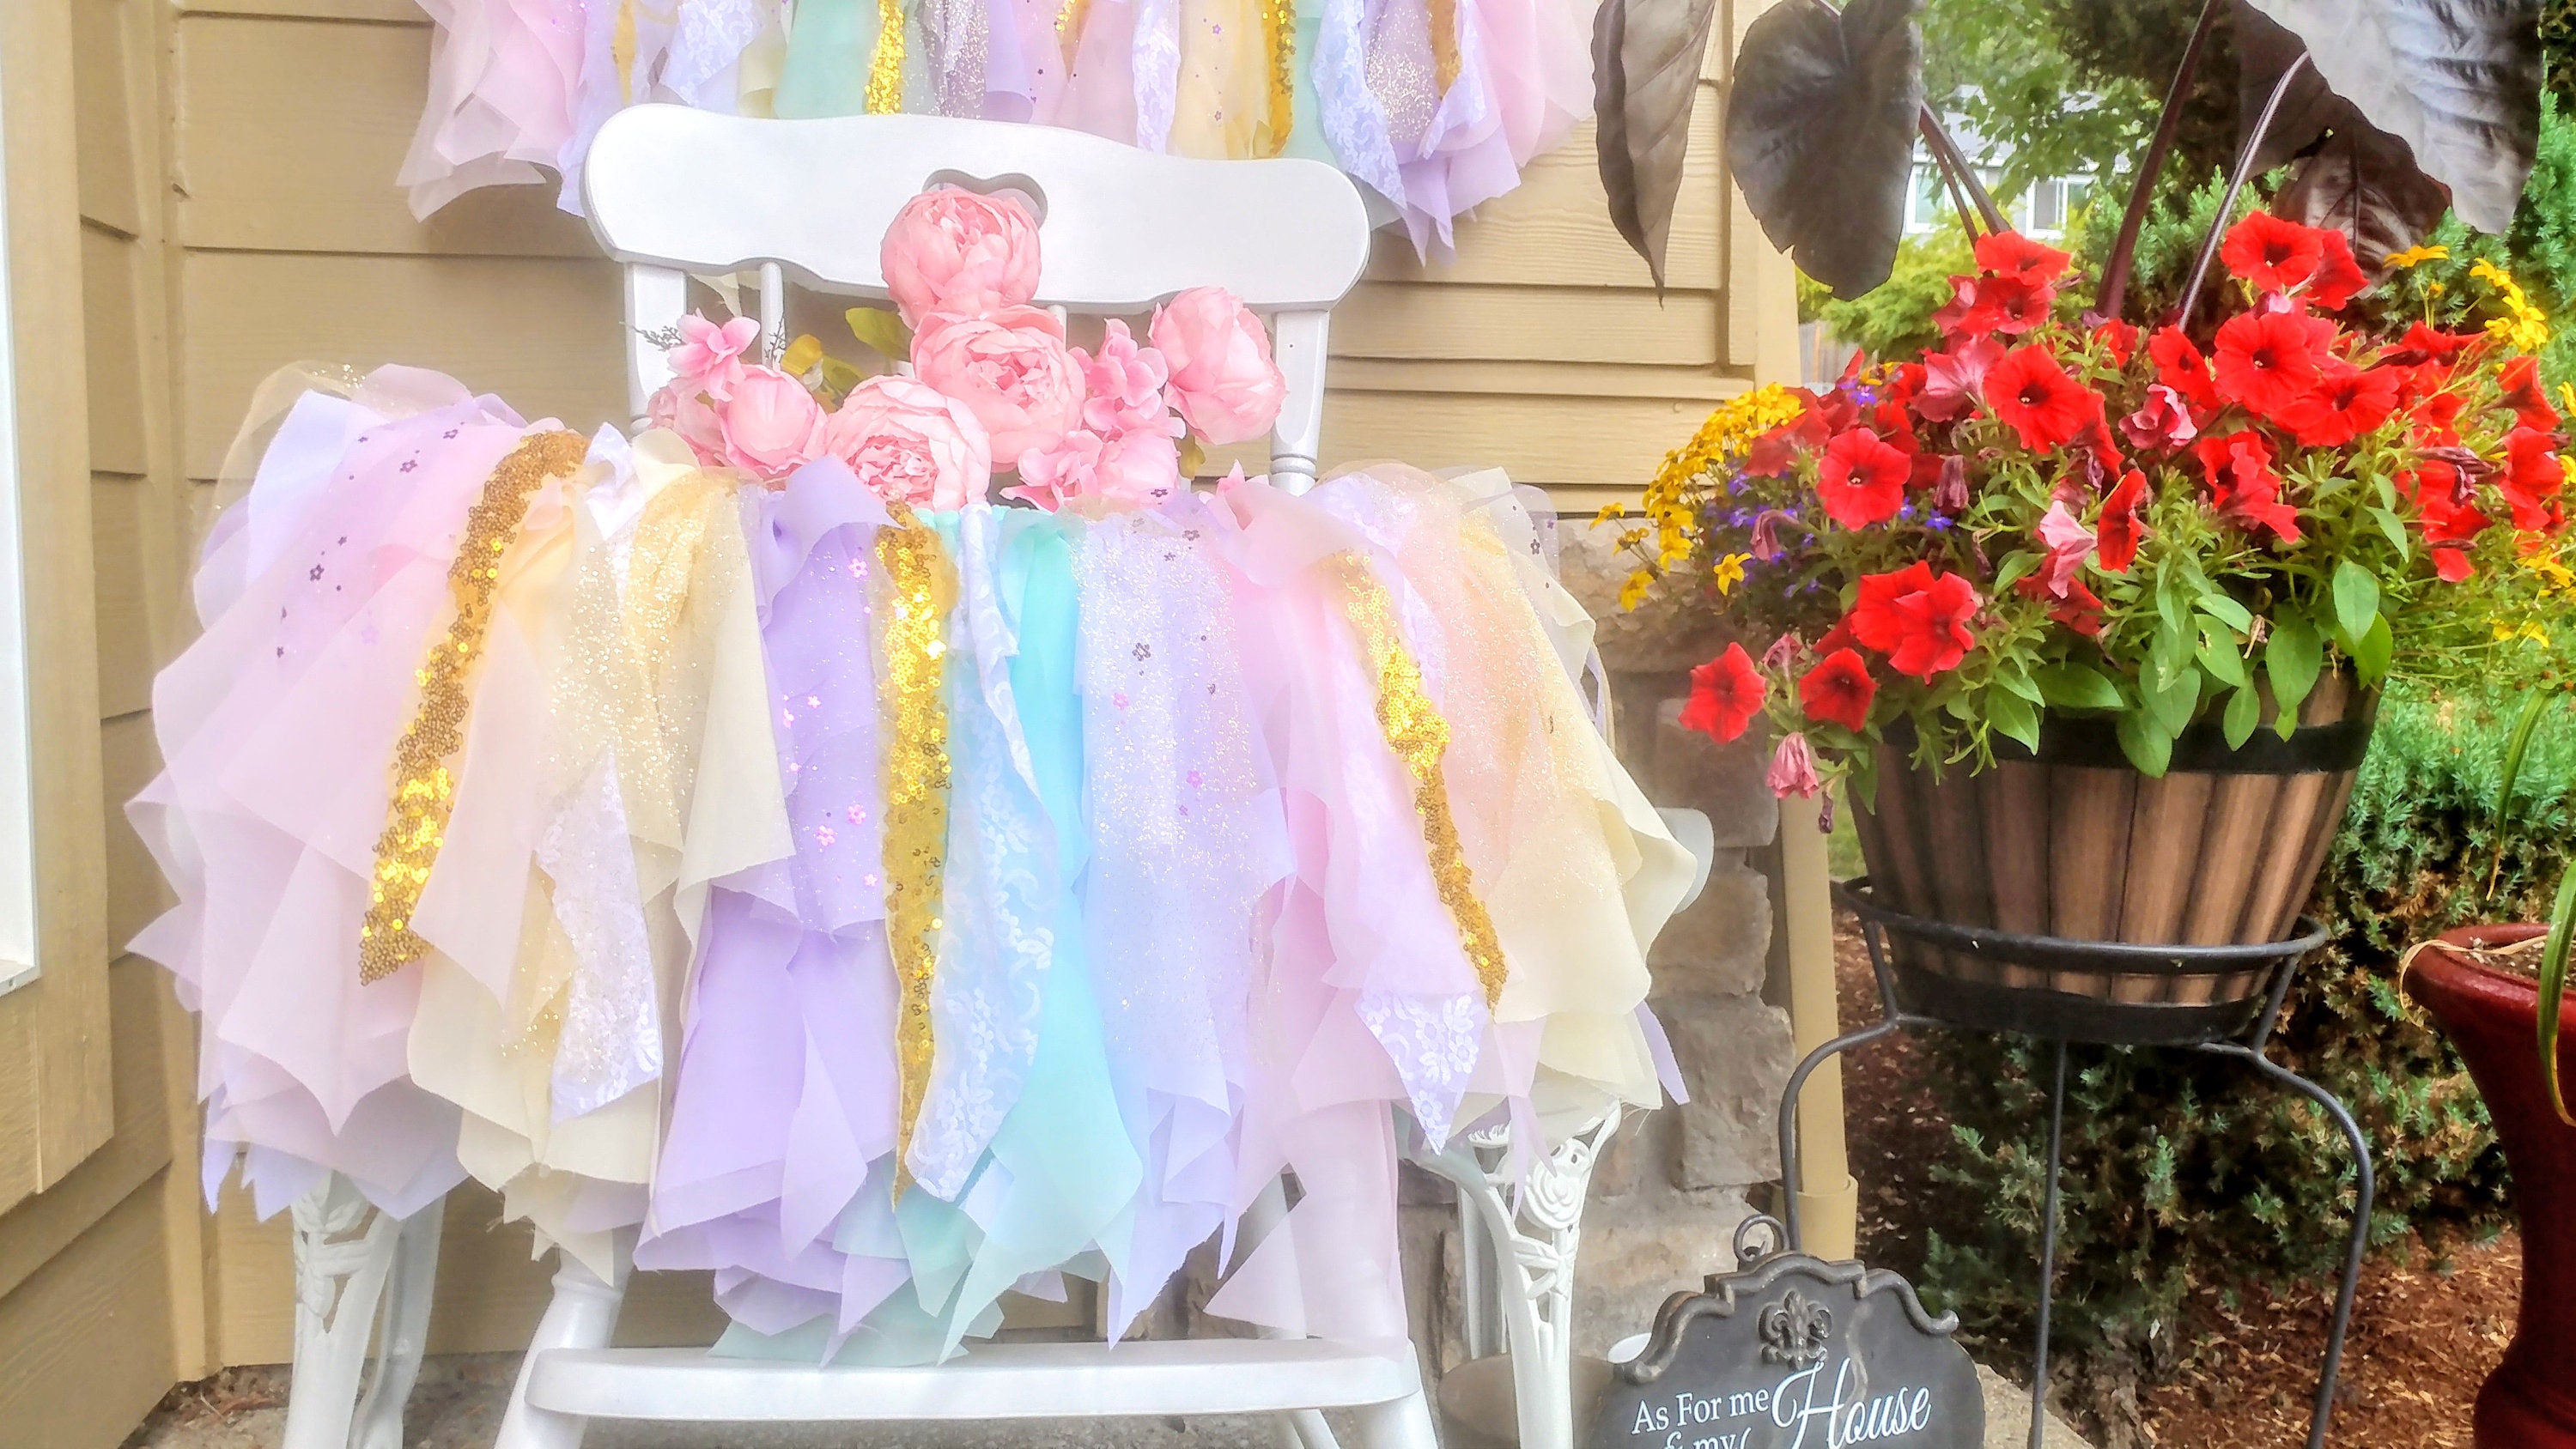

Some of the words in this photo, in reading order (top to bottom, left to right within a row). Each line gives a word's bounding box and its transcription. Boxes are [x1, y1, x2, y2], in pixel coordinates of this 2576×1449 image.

[1631, 1400, 1670, 1434] As
[1675, 1392, 1722, 1427] For
[1729, 1388, 1770, 1417] me
[1771, 1357, 1932, 1449] House
